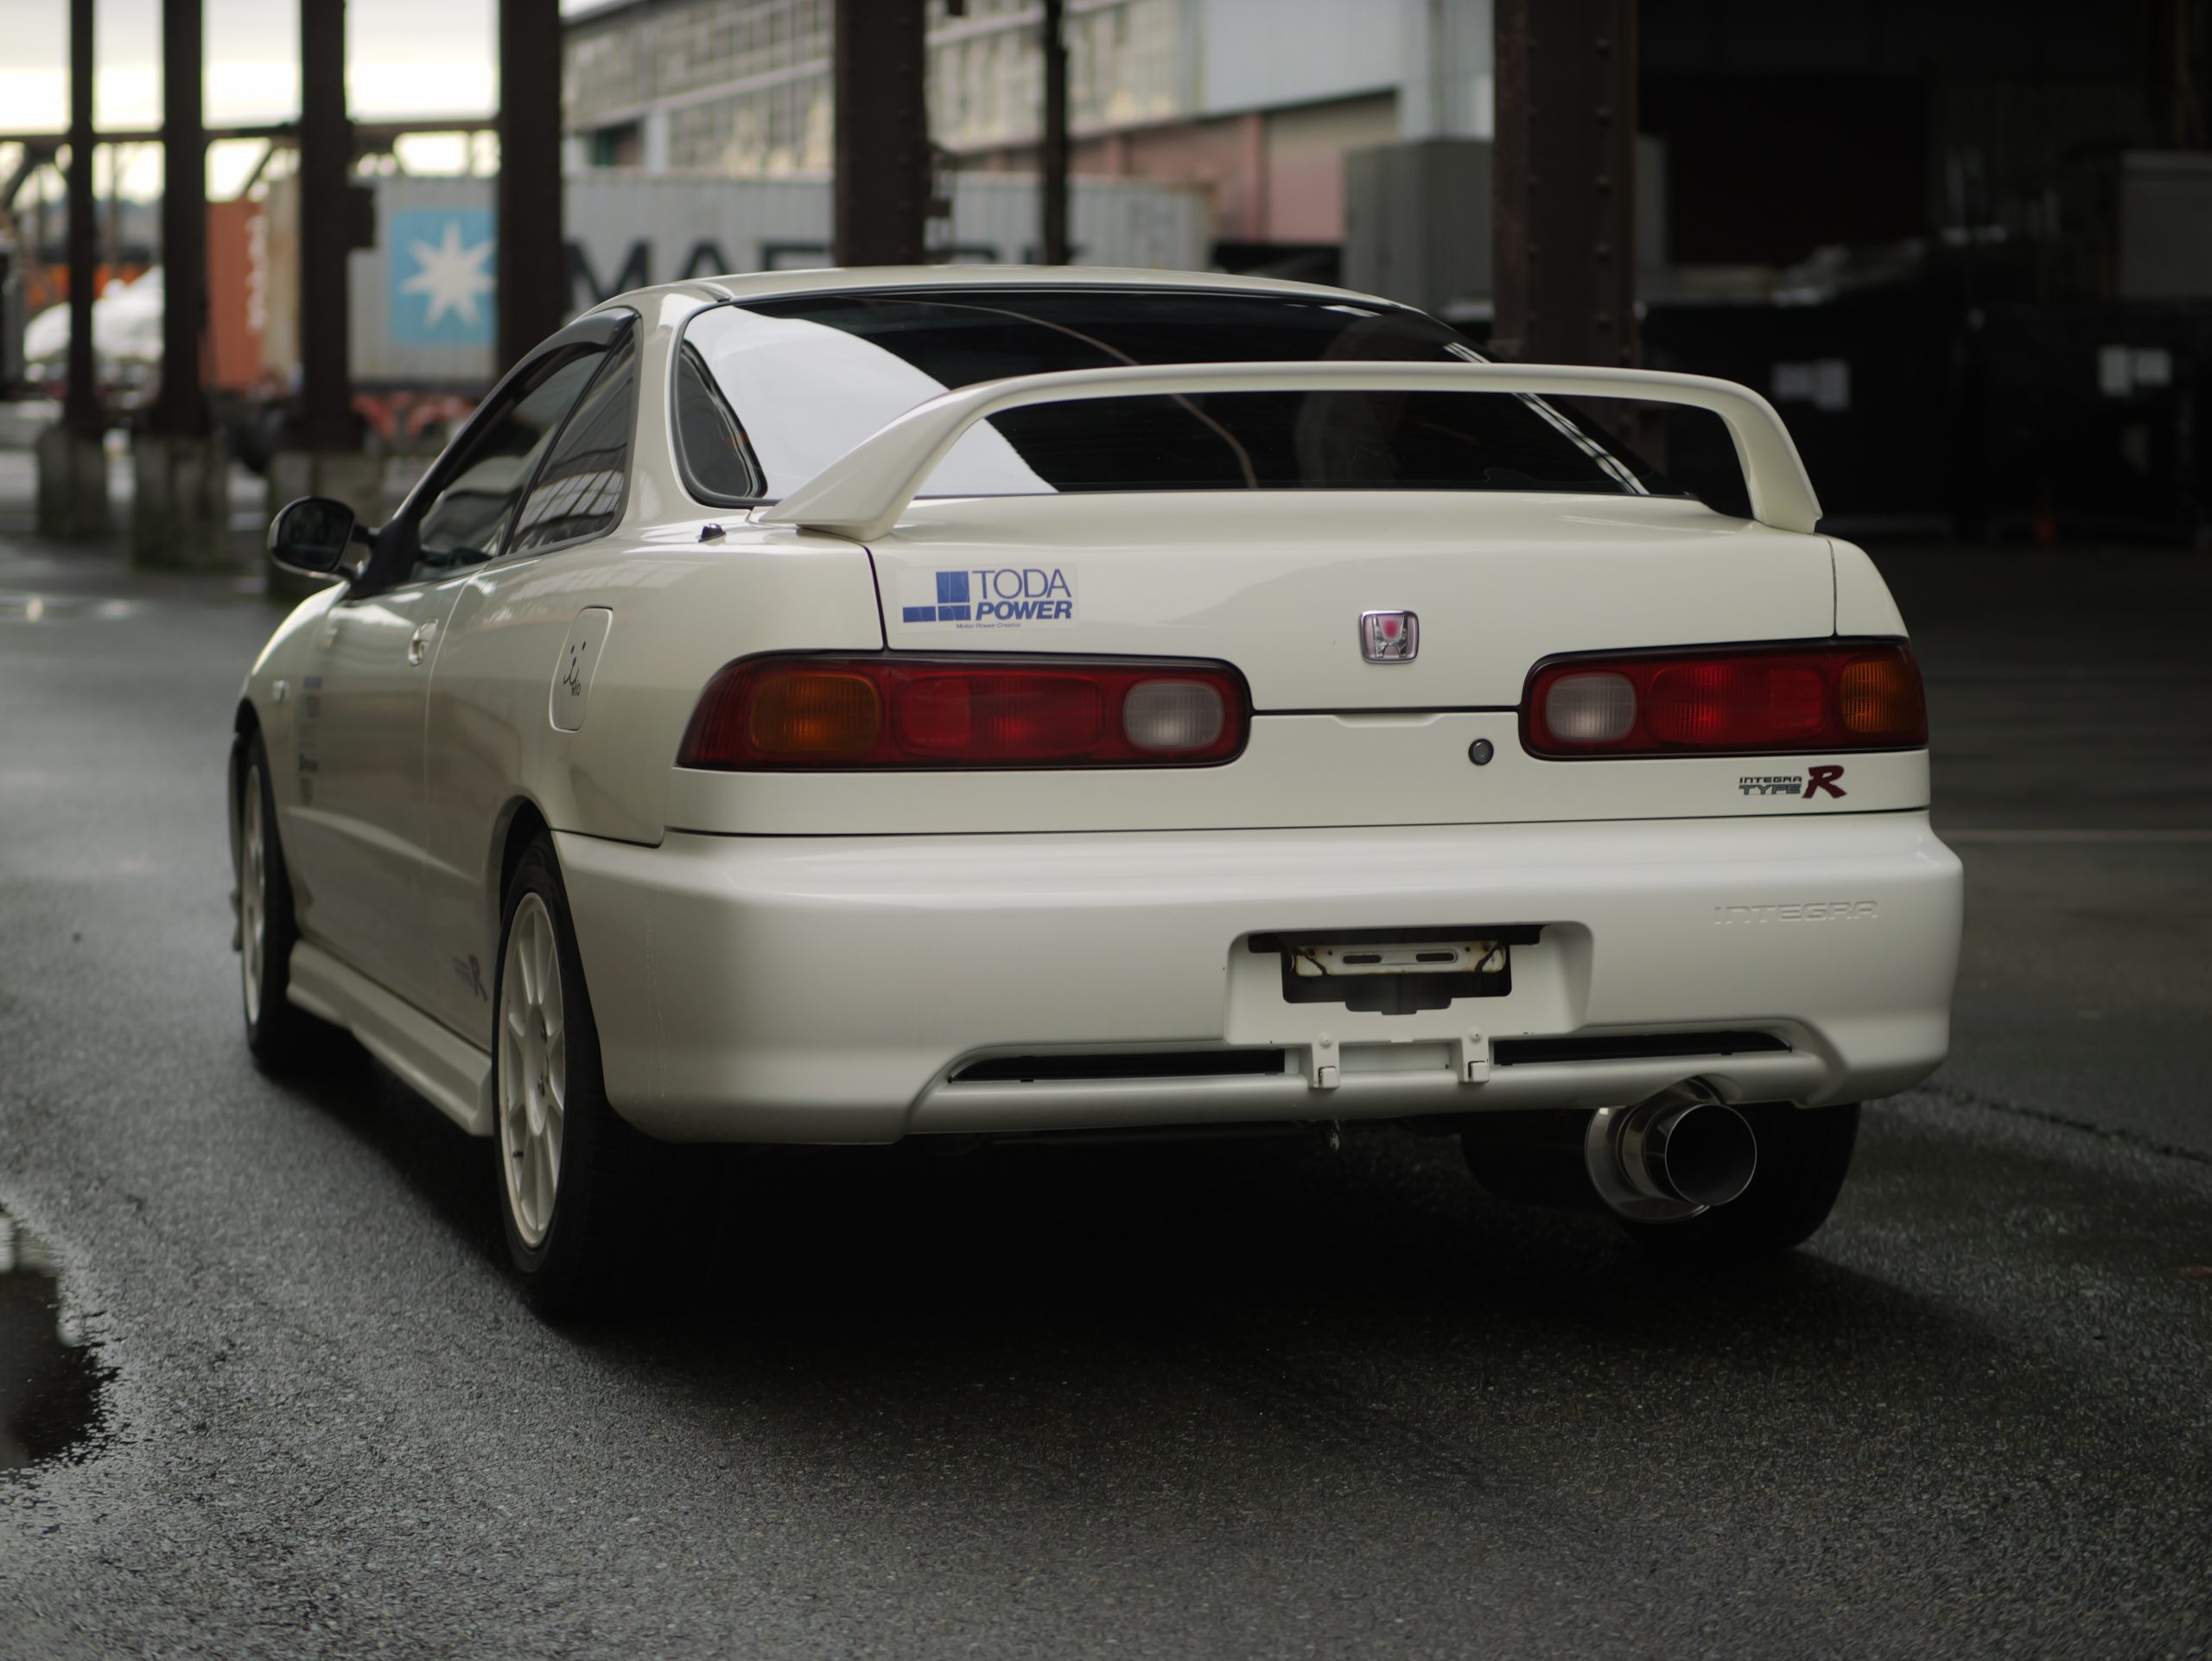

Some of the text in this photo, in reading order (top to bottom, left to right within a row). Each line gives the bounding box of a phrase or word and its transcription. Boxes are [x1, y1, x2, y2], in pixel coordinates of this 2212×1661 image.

[972, 568, 1072, 599] TODA
[976, 600, 1073, 620] POWER
[1738, 765, 1847, 799] TYPE R
[1714, 900, 1878, 925] INTEGRA
